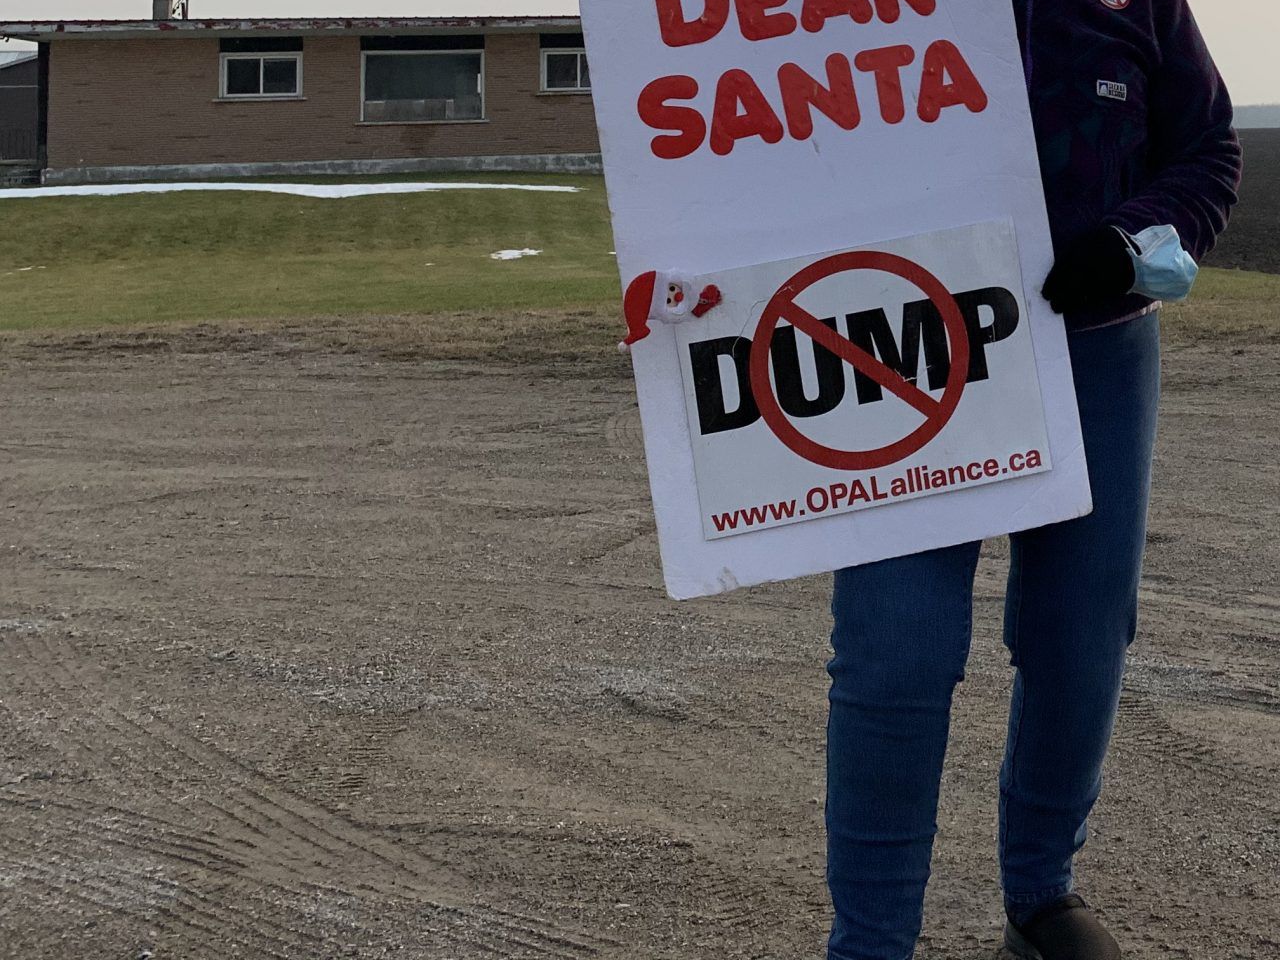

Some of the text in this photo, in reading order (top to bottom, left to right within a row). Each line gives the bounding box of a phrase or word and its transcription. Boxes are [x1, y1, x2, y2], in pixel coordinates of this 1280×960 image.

[636, 39, 988, 160] SANTA
[688, 286, 1021, 436] DUMP
[711, 448, 1042, 532] www.OPALalliance.ca
